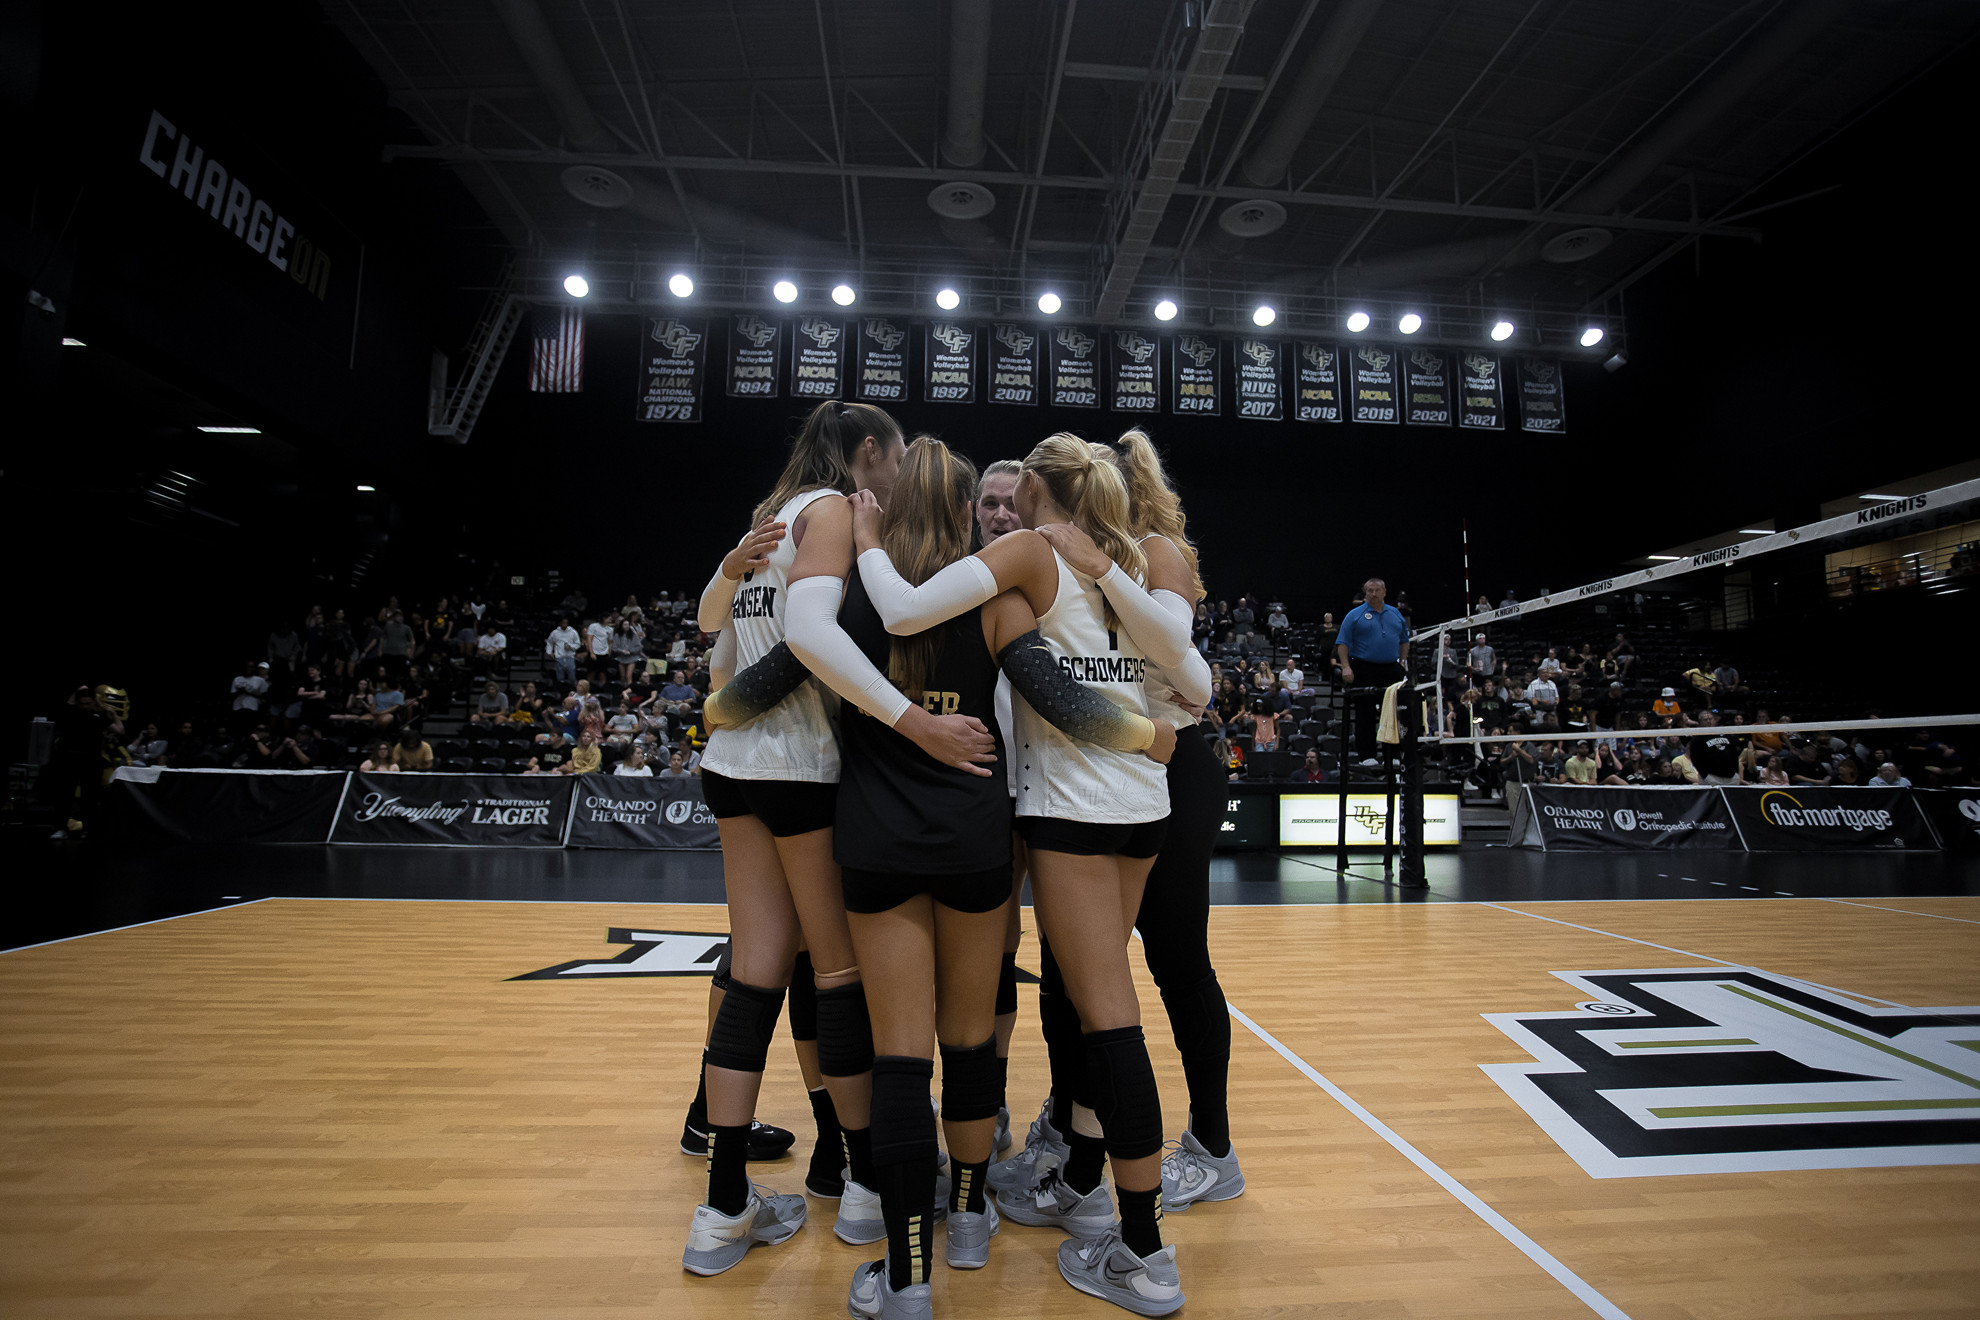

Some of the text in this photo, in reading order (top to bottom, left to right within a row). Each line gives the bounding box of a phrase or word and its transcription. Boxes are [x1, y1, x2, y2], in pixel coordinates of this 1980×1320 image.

[138, 108, 296, 273] CHARGE
[736, 314, 777, 347] UCF
[801, 315, 840, 348] UCF
[865, 317, 905, 351] UCF
[650, 318, 701, 358] UCF
[932, 321, 972, 354] UCF
[993, 323, 1034, 356] UCF
[1055, 325, 1095, 358] UCF
[804, 349, 837, 357] Women's
[1114, 330, 1155, 363] UCF
[1179, 335, 1216, 367] UCF
[1241, 339, 1275, 367] UCF
[653, 358, 694, 366] Women's
[736, 356, 774, 364] Volleyball
[801, 355, 837, 365] Volleyball
[869, 352, 902, 360] Women's
[1000, 356, 1031, 364] Women's
[1358, 344, 1390, 371] UCF
[866, 359, 902, 368] Volleyball
[933, 362, 970, 370] Volleyball
[997, 364, 1032, 372] Volleyball
[1061, 360, 1092, 368] Women's
[1242, 365, 1274, 373] Women's
[649, 366, 695, 376] Volleyball
[734, 366, 772, 379] NCAA
[797, 366, 836, 379] NCAA
[863, 369, 901, 382] NCAA
[1058, 366, 1093, 375] Volleyball
[1119, 371, 1153, 380] Volleyball
[1183, 367, 1212, 375] Women's
[1241, 371, 1275, 380] Volleyball
[1358, 370, 1390, 378] Women's
[931, 372, 968, 384] NCAA
[995, 372, 1031, 386] NCAA
[1056, 376, 1093, 389] NCAA
[1180, 374, 1213, 383] Volleyball
[1358, 375, 1391, 384] Volleyball
[734, 381, 771, 394] 1994
[799, 381, 836, 394] 1995
[864, 384, 901, 397] 1996
[932, 386, 969, 399] 1997
[1116, 381, 1153, 394] NCAA
[1180, 384, 1214, 397] NCAA
[1241, 381, 1276, 394] NIVC
[643, 396, 696, 404] CHAMPIONS
[994, 388, 1031, 402] 2001
[1055, 391, 1096, 405] 2002
[1360, 389, 1389, 401] NCAA
[1116, 396, 1156, 408] 2003
[1179, 397, 1213, 410] 2014
[1241, 401, 1275, 416] 2017
[645, 404, 694, 420] 1978
[1358, 406, 1394, 420] 2019
[1857, 494, 1926, 523] KNIGHTS
[1692, 545, 1739, 567] KNIGHTS
[1579, 580, 1612, 596] KNIGHTS
[1494, 605, 1520, 618] KNIGHTS
[1060, 656, 1146, 683] SCHOMERS
[354, 792, 469, 825] Yuengling
[483, 798, 547, 807] TRADITIONAL
[586, 796, 657, 812] ORLANDO
[471, 806, 549, 826] LAGER
[591, 809, 648, 825] HEALTH
[1543, 805, 1604, 819] ORLANDO
[1636, 810, 1662, 820] Jewett
[1769, 803, 1892, 831] fbc mortgage
[1354, 806, 1386, 835] UCF
[1553, 817, 1602, 830] HEALTH
[1639, 821, 1691, 833] Orthopedic
